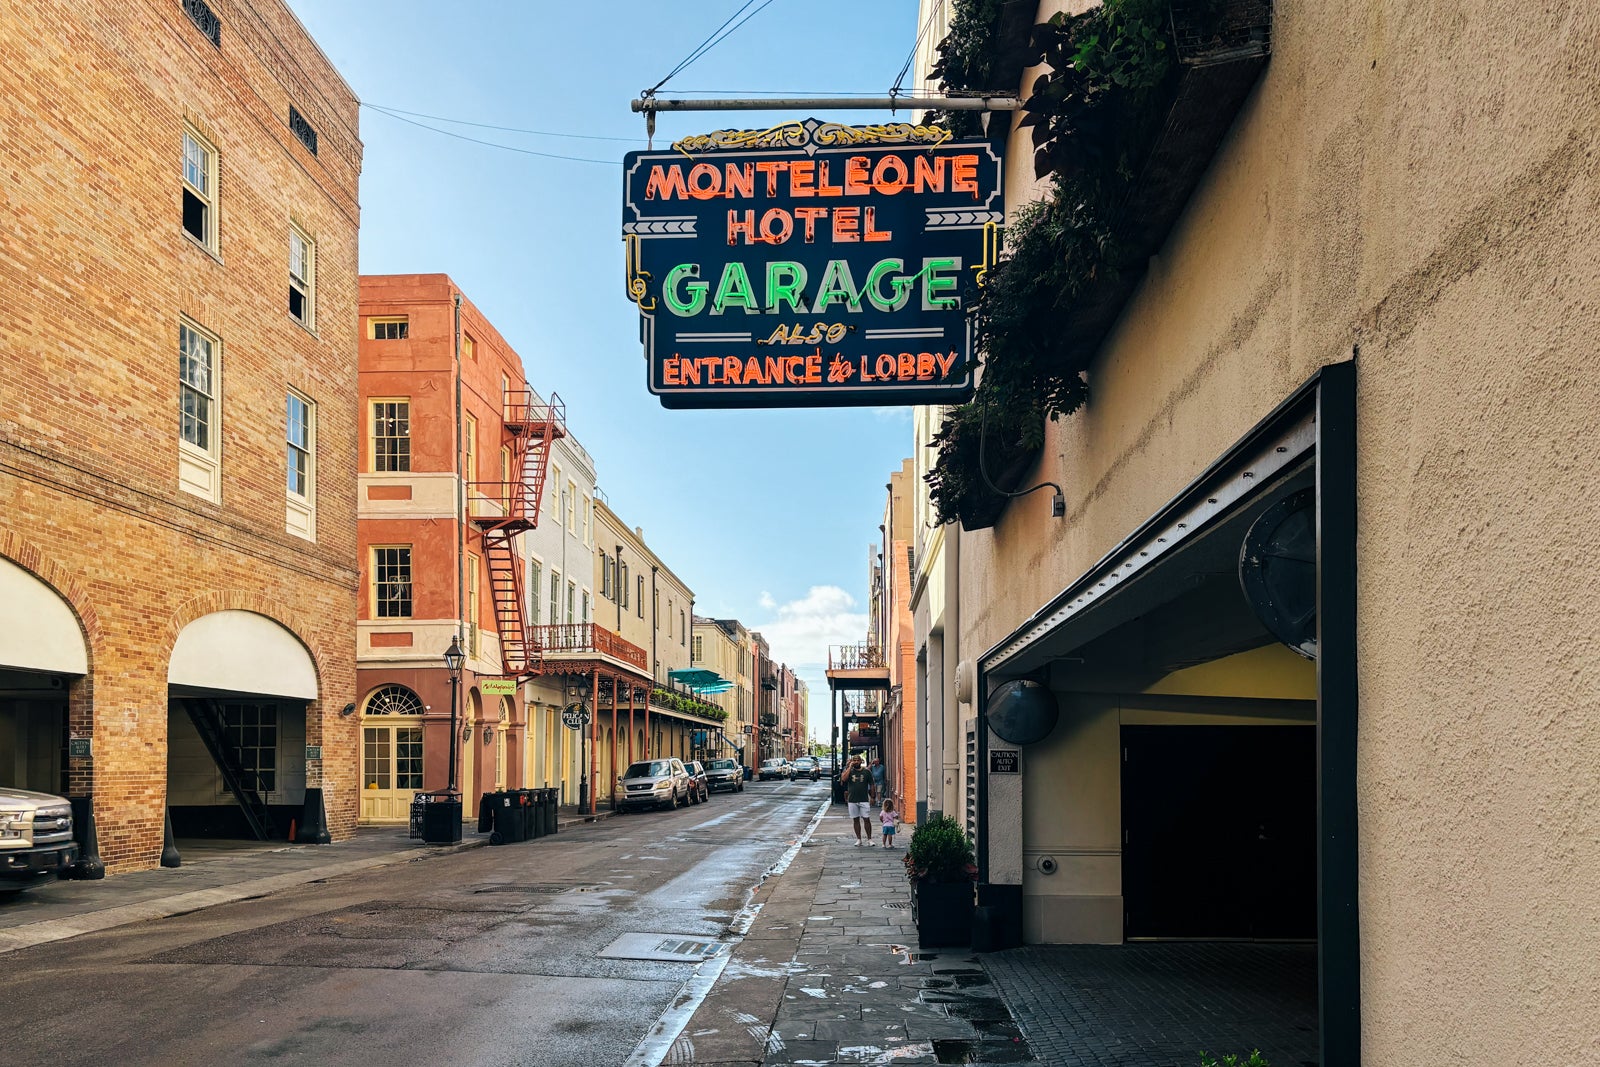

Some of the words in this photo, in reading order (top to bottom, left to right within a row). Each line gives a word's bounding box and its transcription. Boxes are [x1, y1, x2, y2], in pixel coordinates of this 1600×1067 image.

[645, 154, 979, 200] MONTELEONE
[727, 206, 892, 246] HOTEL
[662, 256, 963, 317] GARAGE
[764, 322, 848, 345] ALSO
[663, 354, 823, 385] ENTRANCE
[827, 353, 854, 384] to
[860, 352, 958, 382] LOBBY
